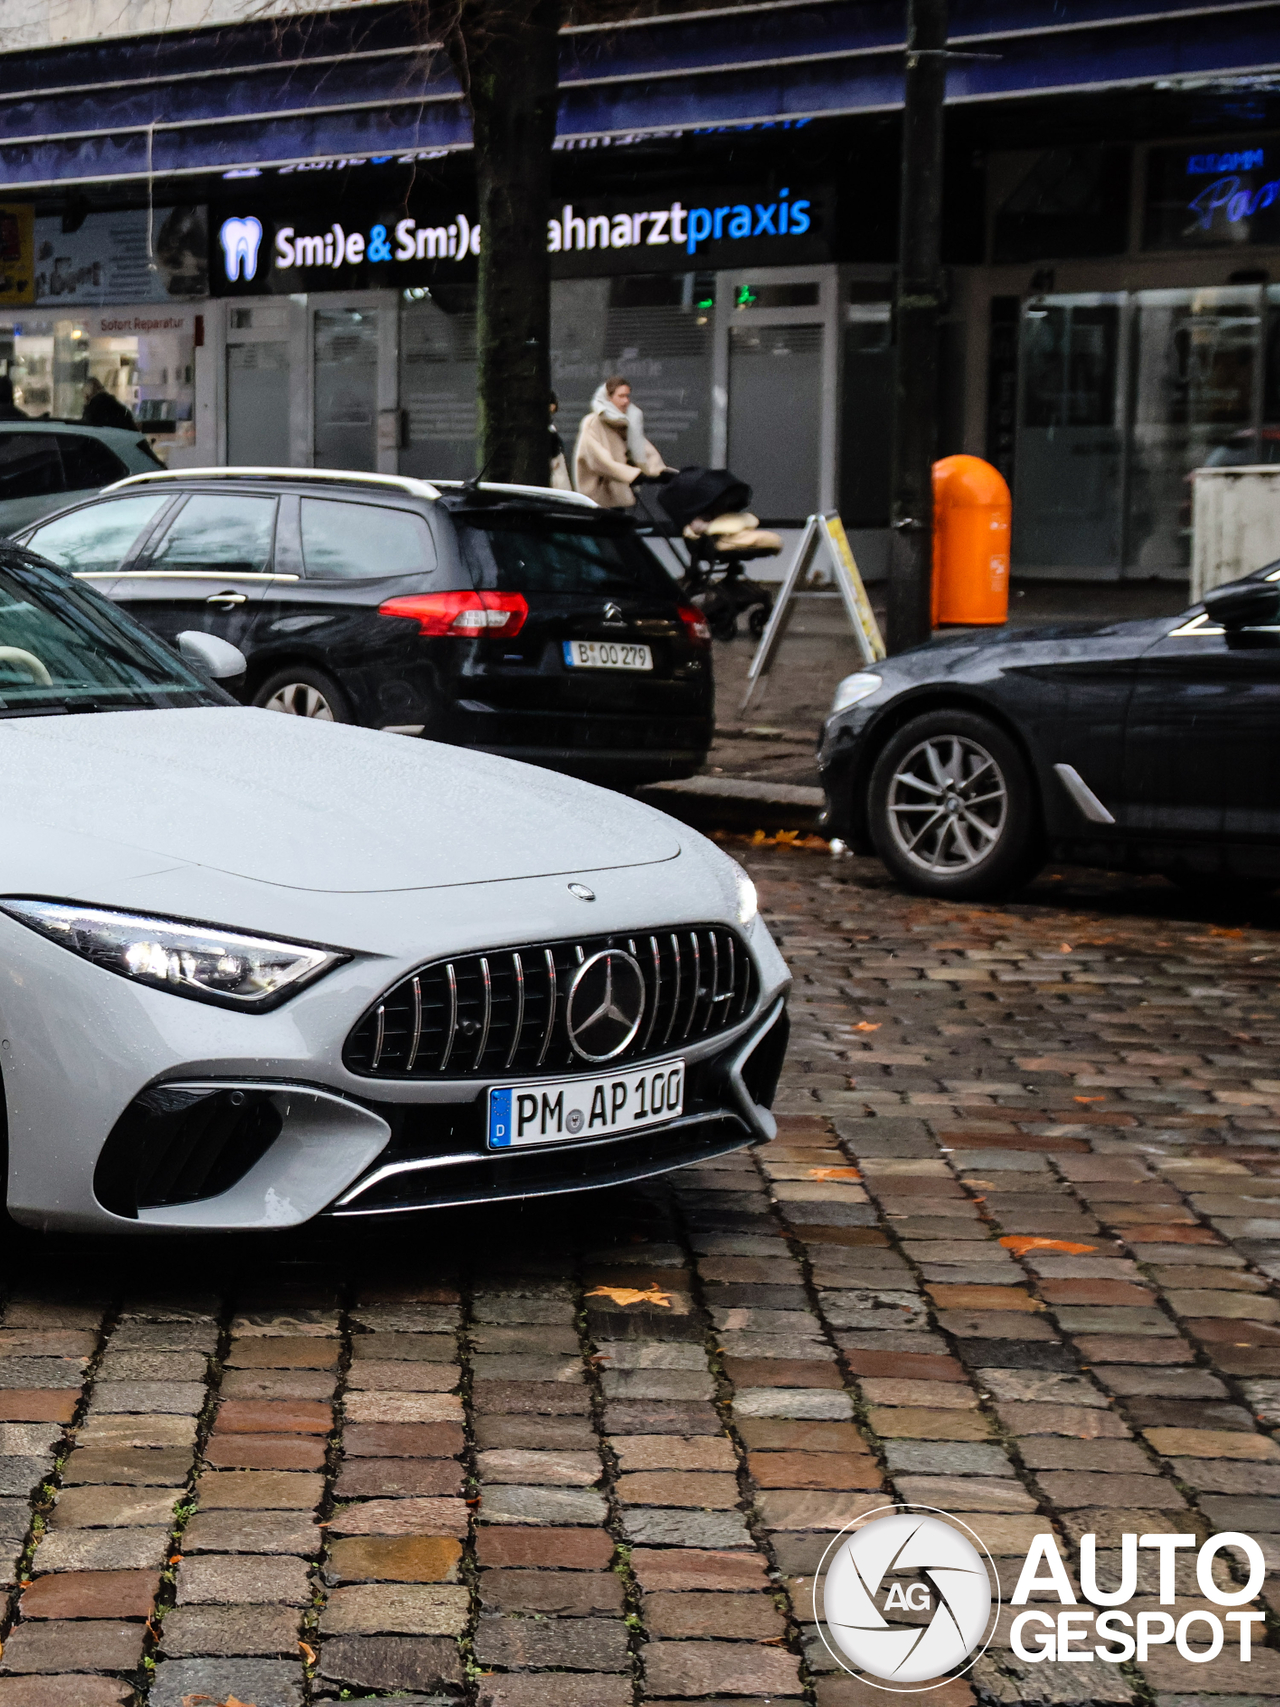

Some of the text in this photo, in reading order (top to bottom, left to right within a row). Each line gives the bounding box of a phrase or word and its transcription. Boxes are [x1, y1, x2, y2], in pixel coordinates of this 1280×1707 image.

[366, 225, 392, 262] &
[547, 188, 812, 255] ahnarztpraxis
[101, 317, 184, 333] Sofort Reparatur
[579, 645, 588, 663] B
[621, 647, 648, 667] 279
[496, 1068, 682, 1137] D PM AP 100
